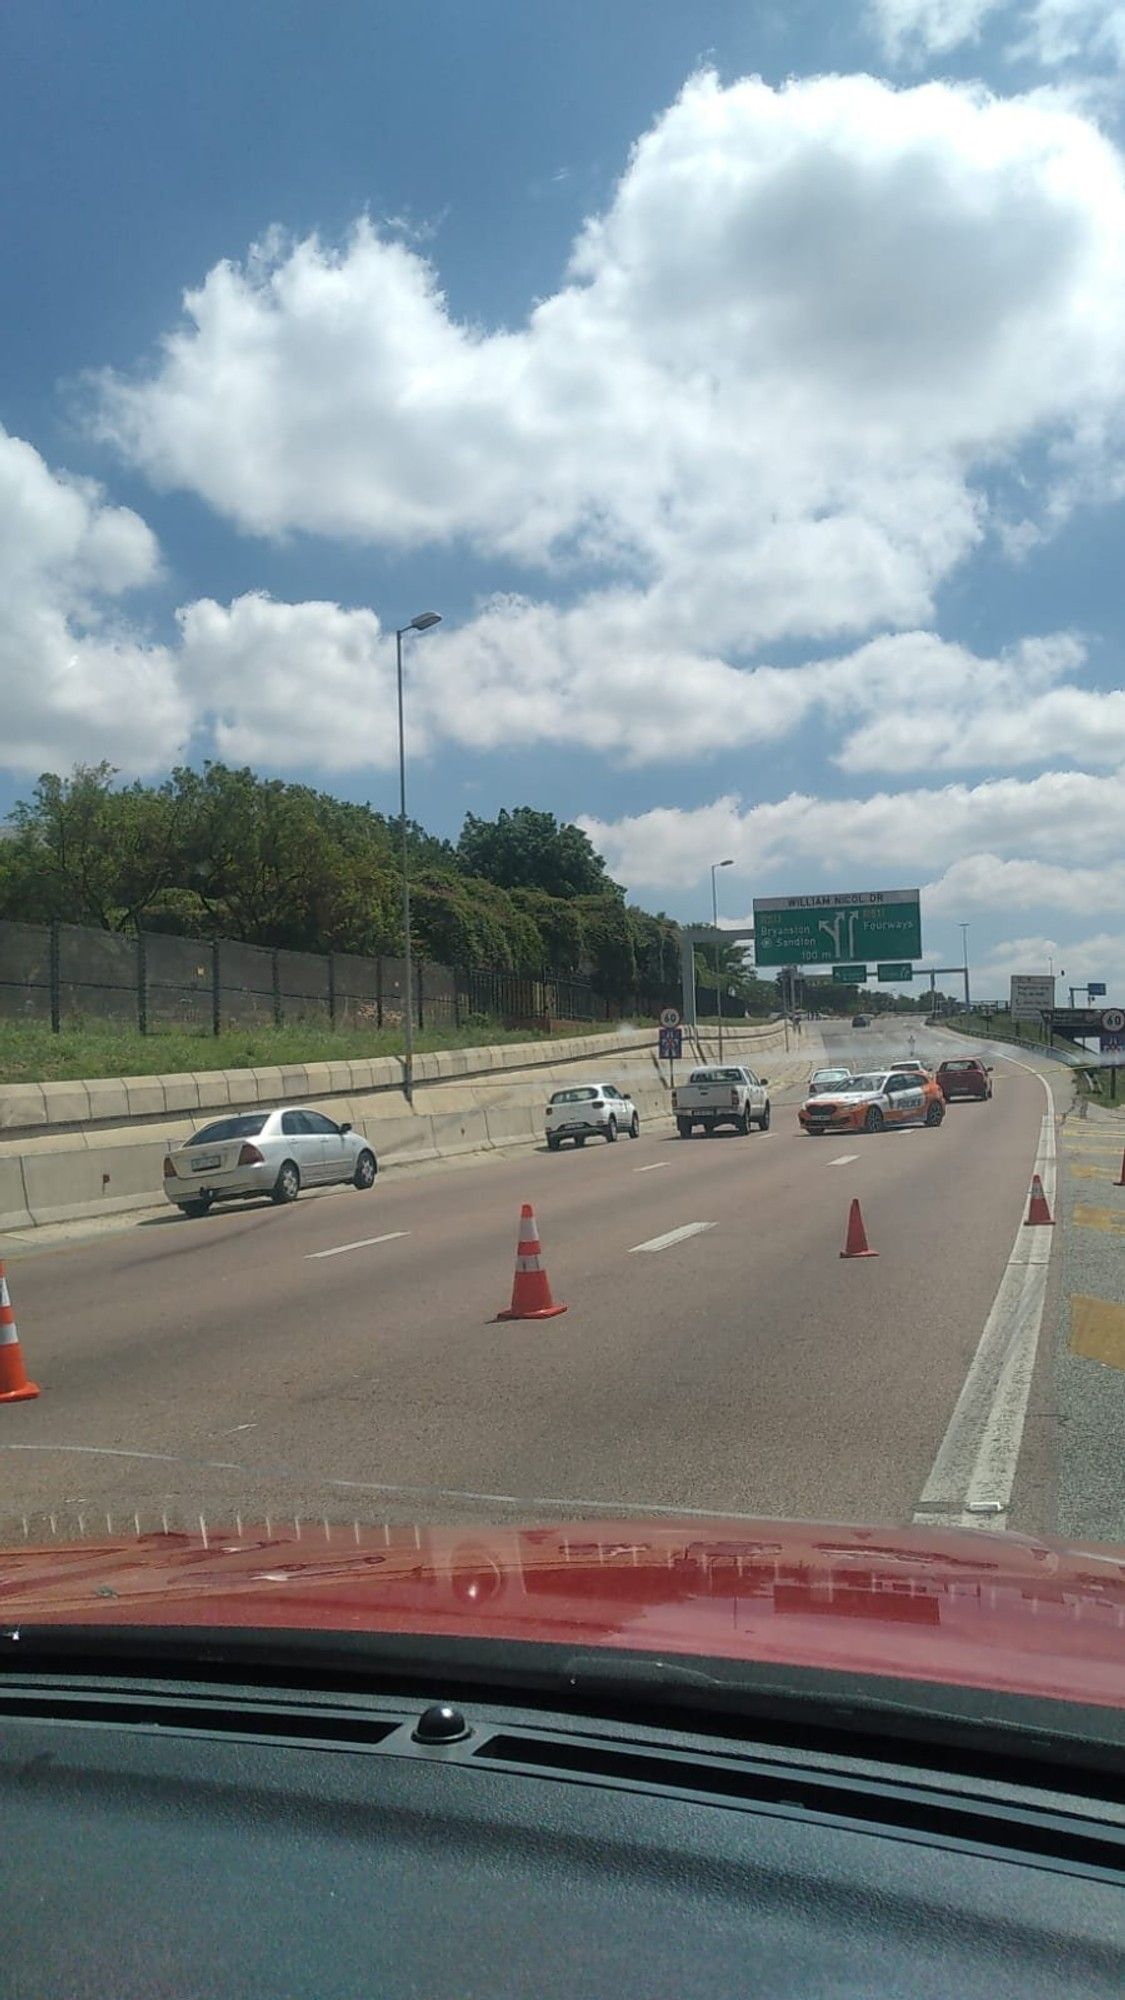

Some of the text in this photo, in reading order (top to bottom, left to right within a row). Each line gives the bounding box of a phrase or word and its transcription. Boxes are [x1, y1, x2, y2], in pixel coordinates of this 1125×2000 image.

[788, 893, 884, 908] WILLIAM NICOL DR
[863, 919, 914, 931] Fourways
[664, 1013, 677, 1023] 60
[1106, 1014, 1121, 1025] 60
